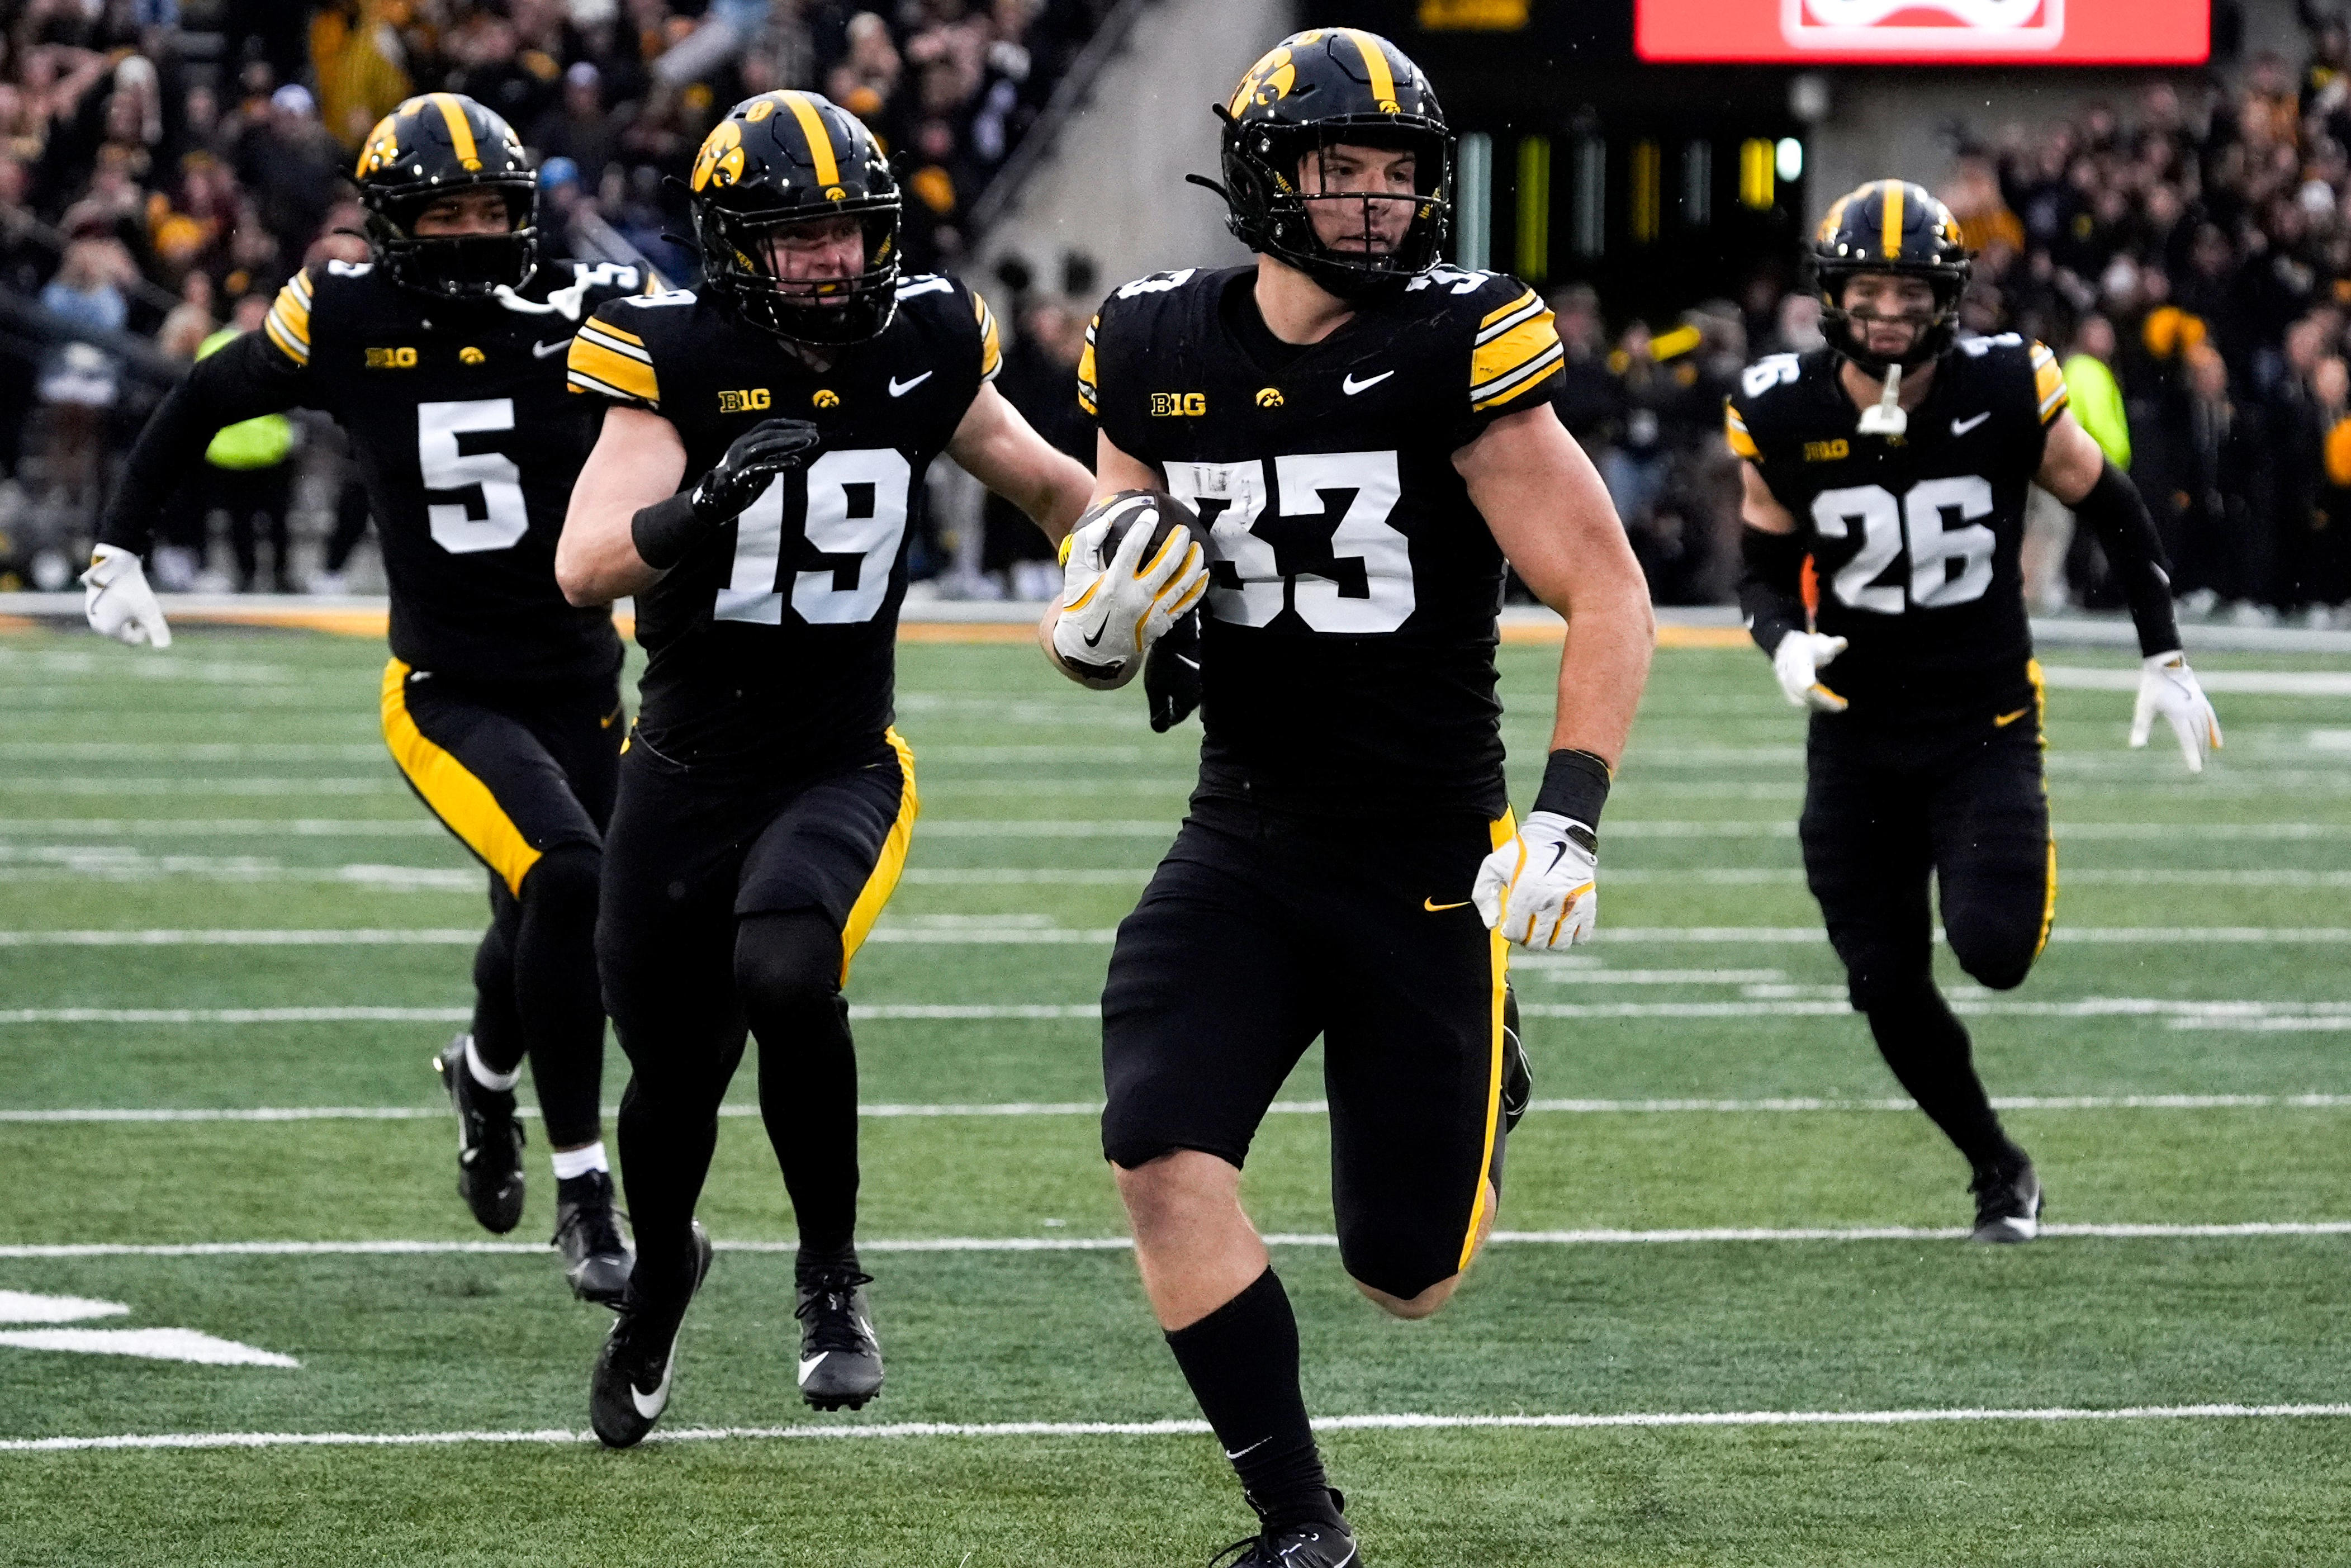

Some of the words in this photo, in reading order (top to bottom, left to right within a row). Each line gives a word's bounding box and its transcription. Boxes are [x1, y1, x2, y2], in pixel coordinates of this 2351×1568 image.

[418, 397, 529, 555] 5
[713, 448, 911, 625] 19
[1163, 450, 1416, 633] 33
[1810, 475, 1996, 614] 26
